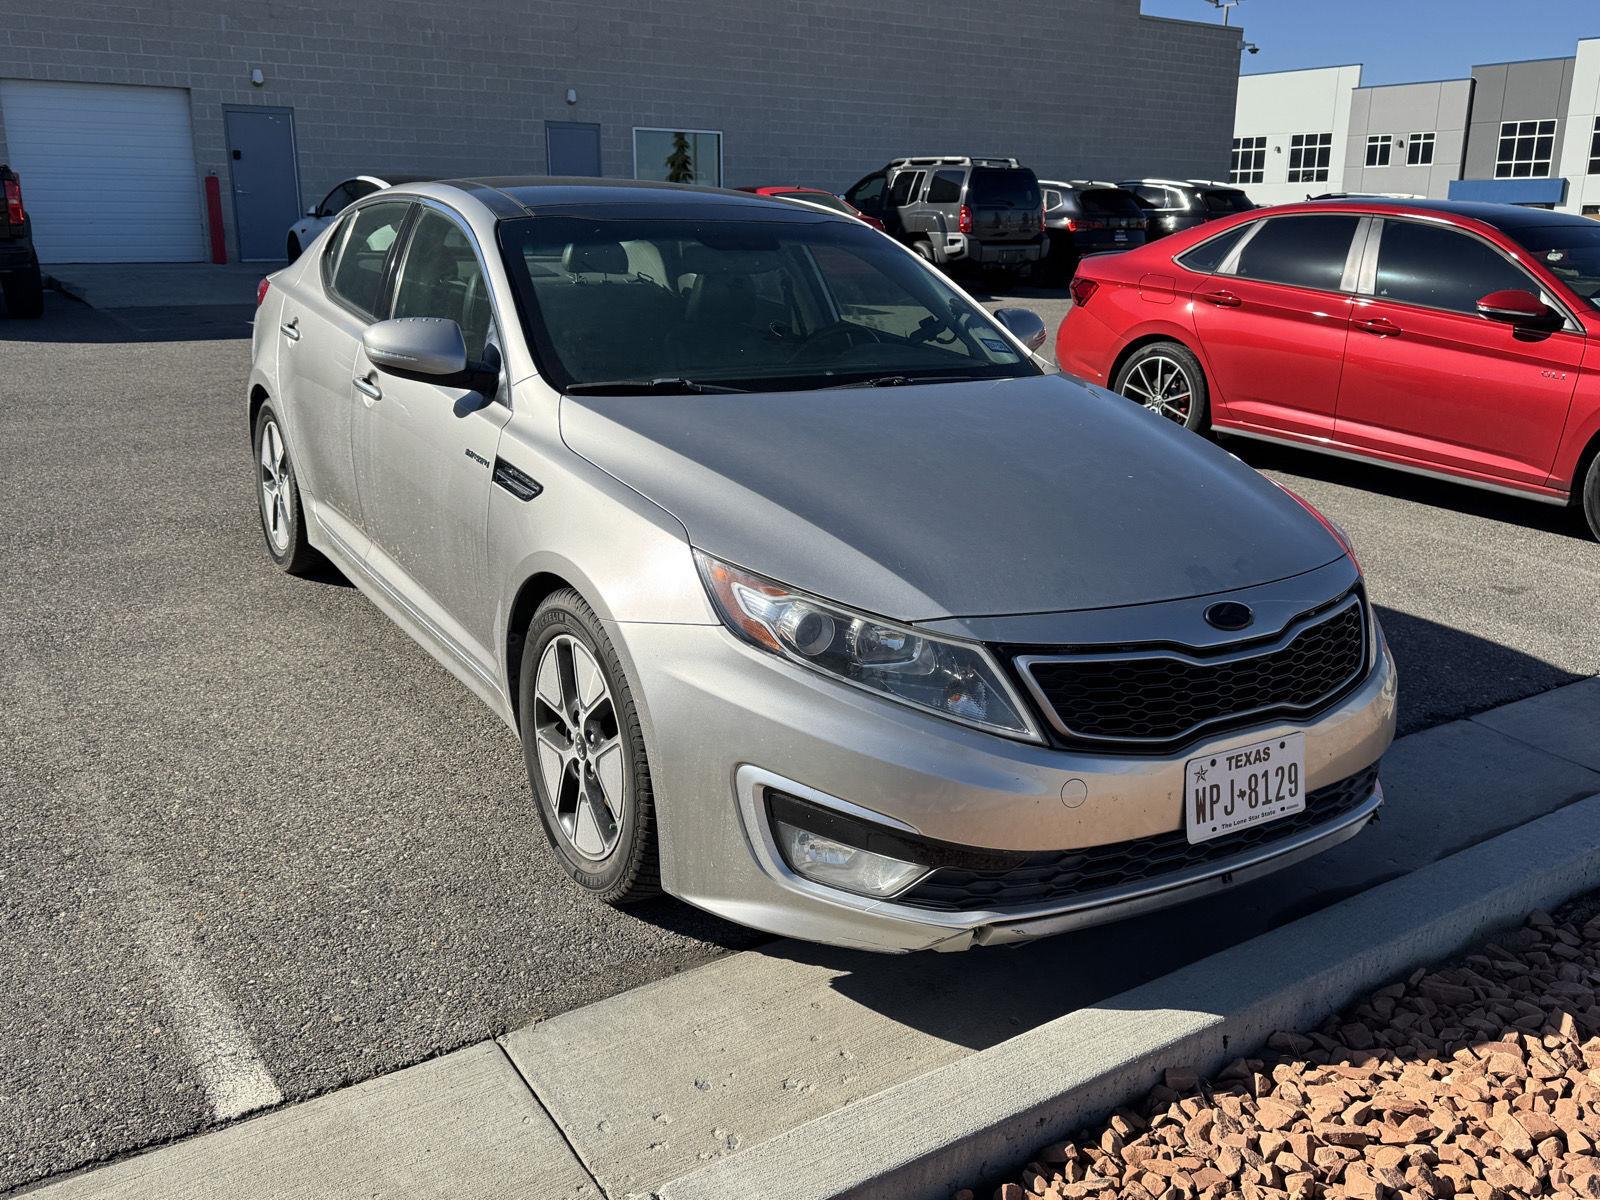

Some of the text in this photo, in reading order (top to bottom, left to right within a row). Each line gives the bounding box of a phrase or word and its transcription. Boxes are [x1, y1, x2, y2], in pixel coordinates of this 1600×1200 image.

[1226, 747, 1270, 771] TEXAS
[1248, 814, 1260, 822] Star
[1261, 810, 1276, 818] State
